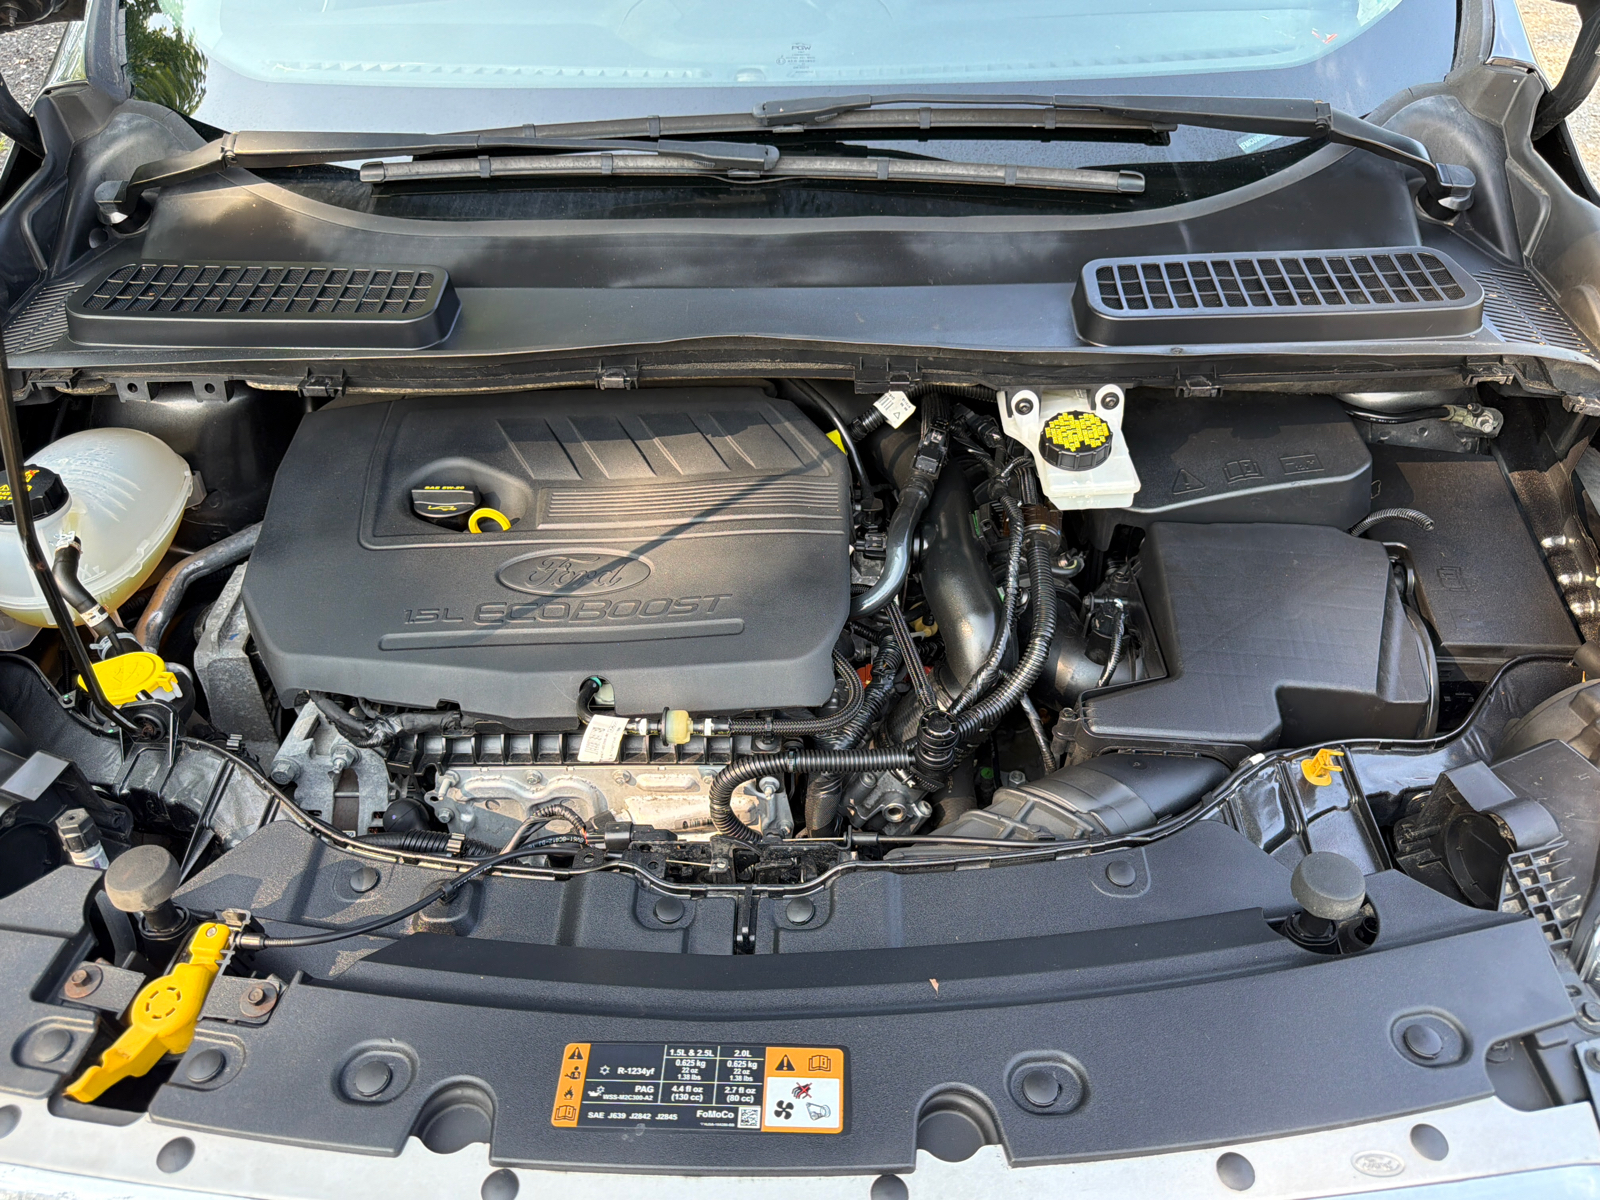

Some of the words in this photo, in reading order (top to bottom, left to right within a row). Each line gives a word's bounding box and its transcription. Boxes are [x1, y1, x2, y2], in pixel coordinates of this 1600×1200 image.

[526, 555, 623, 588] Ford
[670, 1048, 686, 1056] 1.5L
[697, 1049, 714, 1057] 2.5L
[675, 1059, 695, 1067] 0.625
[696, 1059, 706, 1068] kg
[747, 1060, 758, 1070] kg
[617, 1067, 656, 1076] R-1234yf
[634, 1085, 654, 1093] PAG
[670, 1094, 689, 1102] (130
[690, 1094, 704, 1102] cc)
[726, 1095, 740, 1103] (80
[740, 1096, 754, 1104] cc)
[655, 1113, 678, 1121] J2845
[696, 1110, 735, 1119] FoMoCo
